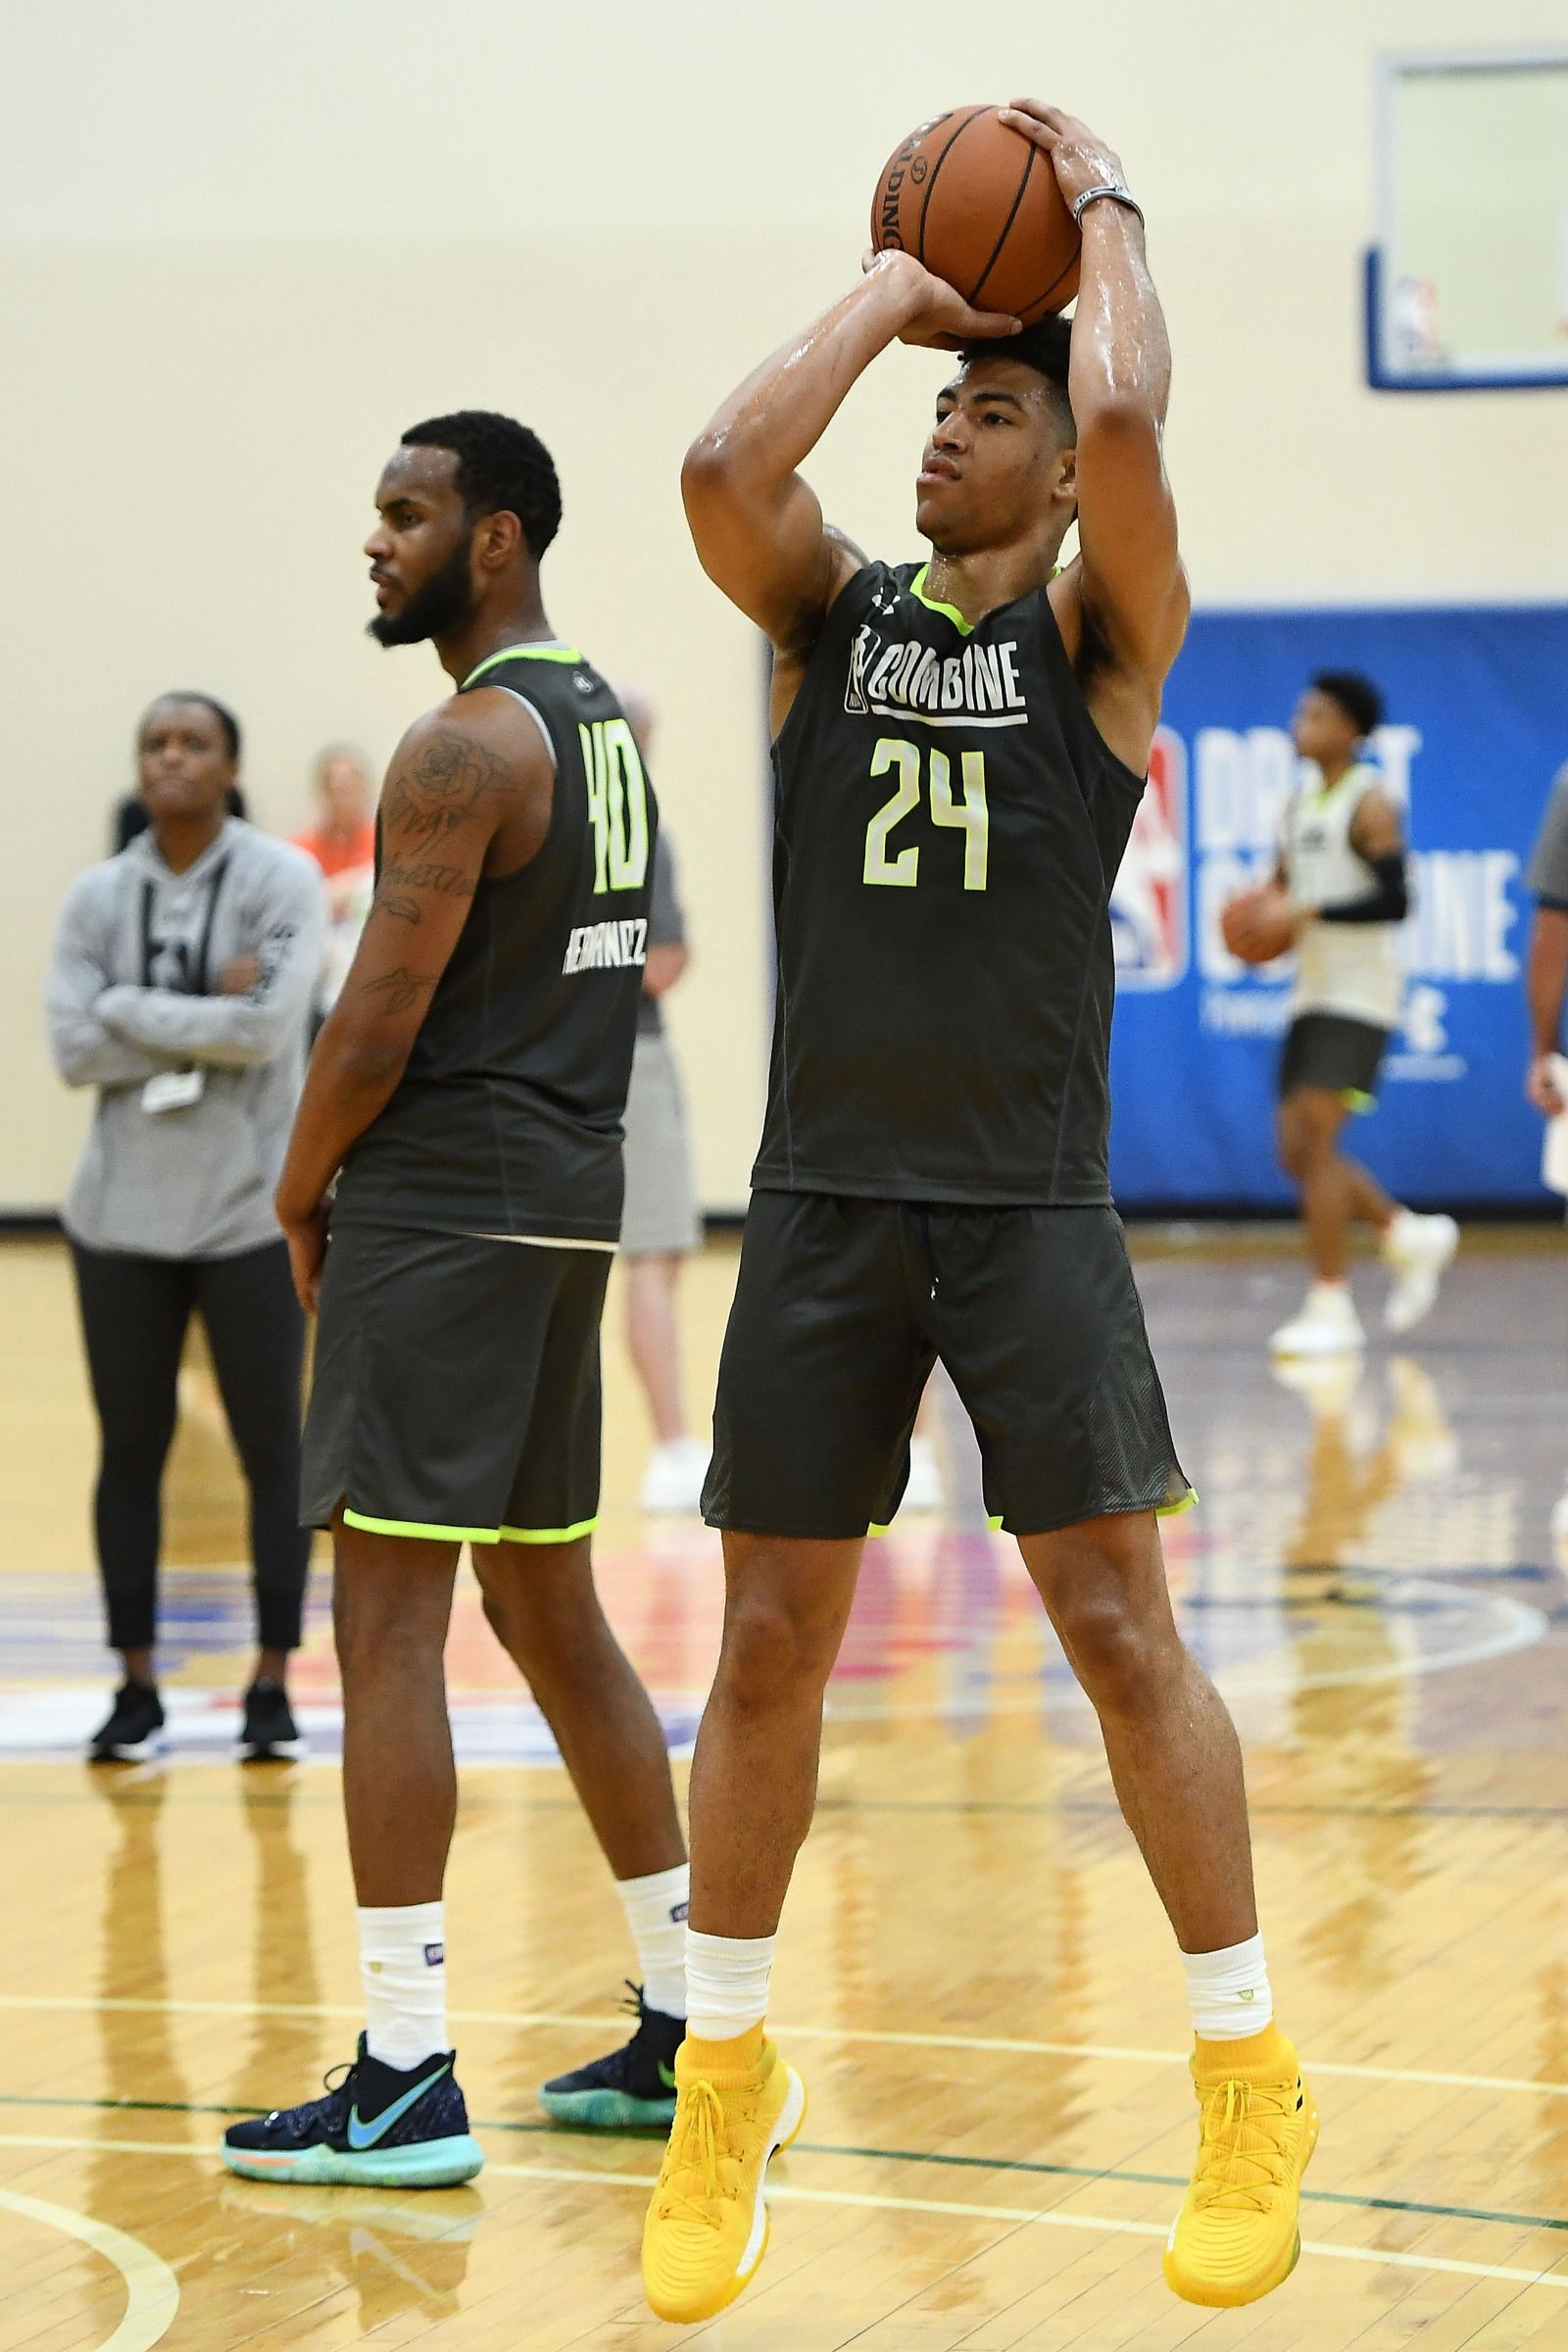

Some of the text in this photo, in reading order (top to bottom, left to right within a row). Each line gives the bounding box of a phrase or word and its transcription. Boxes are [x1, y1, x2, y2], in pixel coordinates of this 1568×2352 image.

[867, 640, 1026, 711] COMBINE
[578, 717, 649, 895] 40
[862, 737, 989, 891] 24
